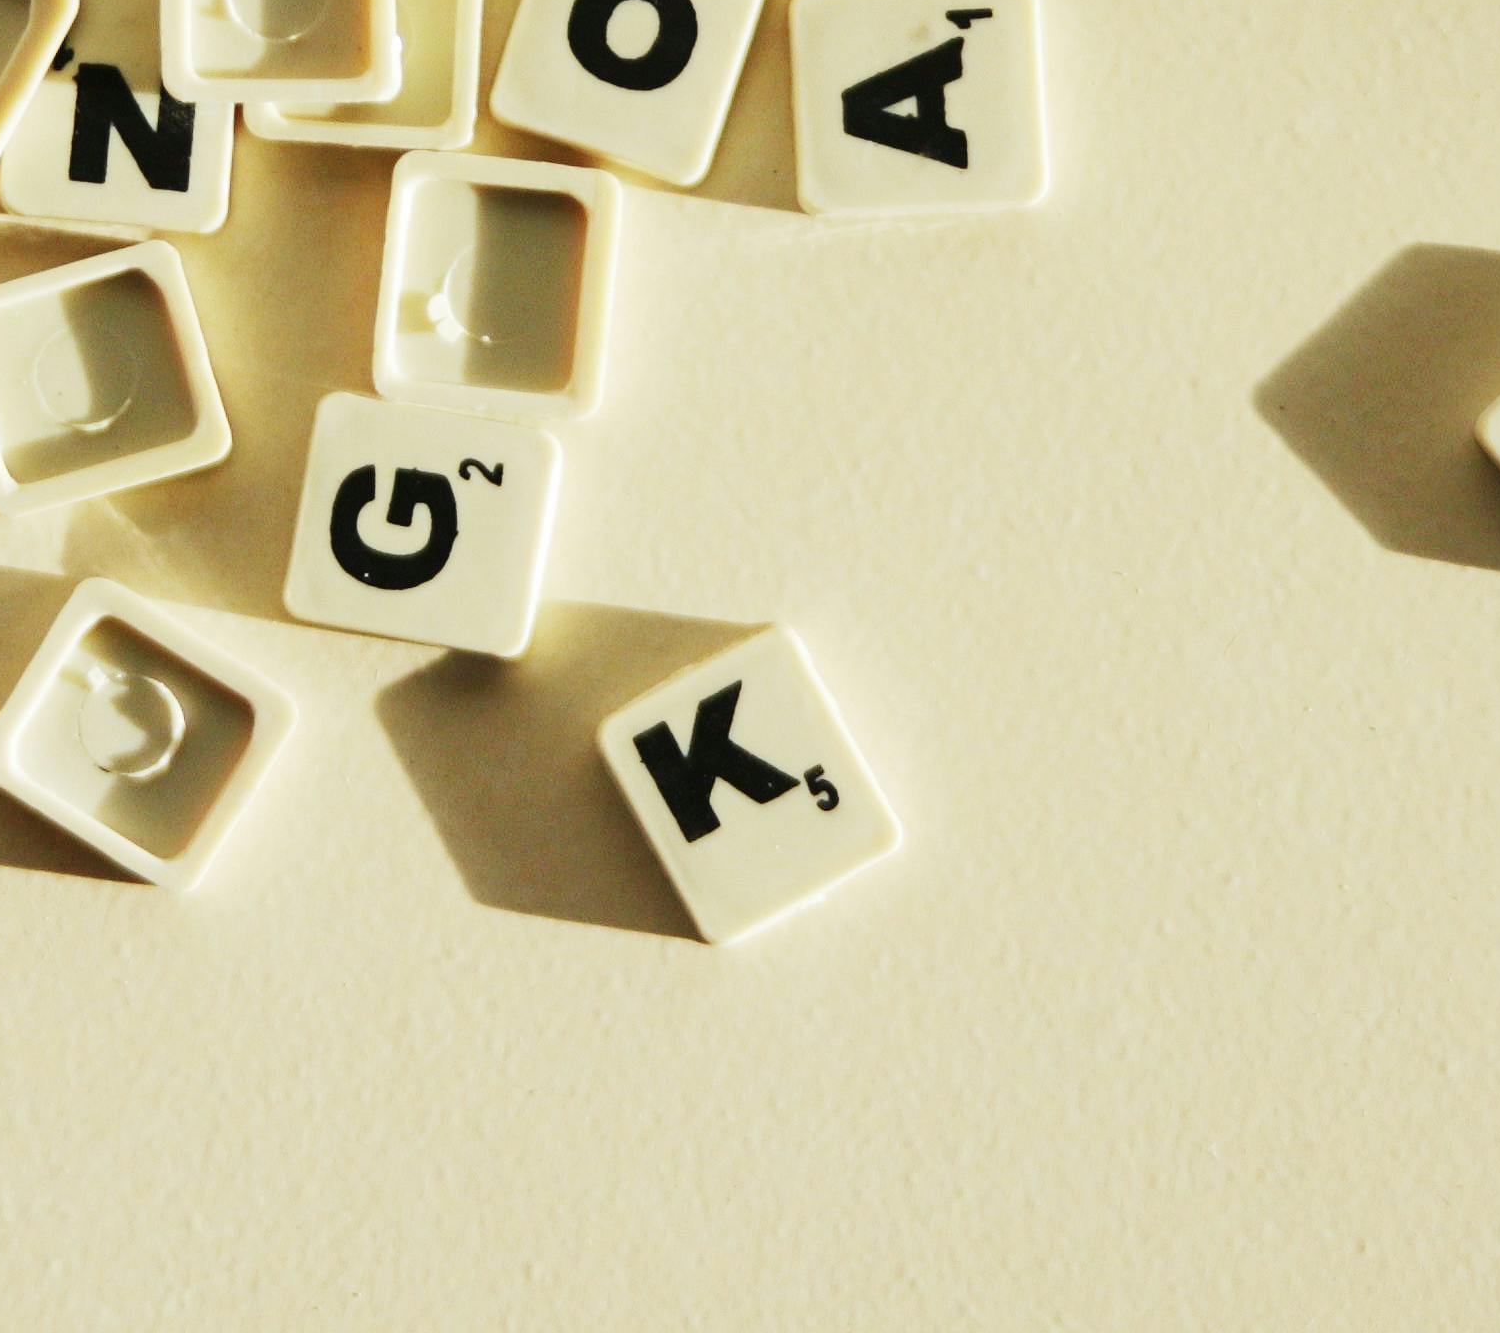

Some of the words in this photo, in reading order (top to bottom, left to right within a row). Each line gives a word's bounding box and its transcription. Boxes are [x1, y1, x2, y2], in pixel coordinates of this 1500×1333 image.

[69, 62, 195, 192] N
[842, 37, 968, 169] A
[946, 9, 992, 29] 1
[330, 465, 458, 590] G
[459, 459, 503, 486] 2
[632, 680, 801, 844] K
[804, 765, 839, 811] 5
